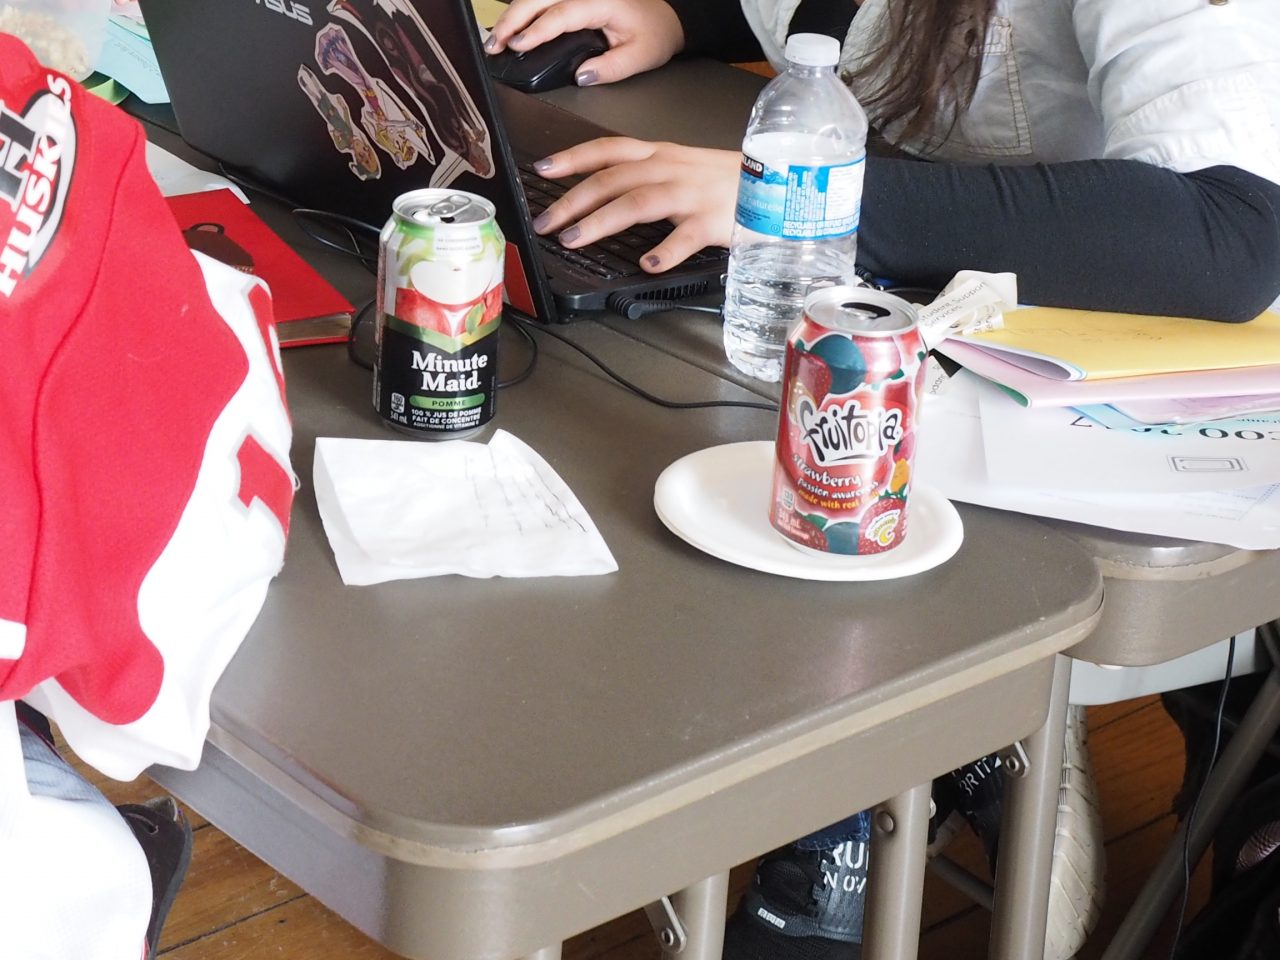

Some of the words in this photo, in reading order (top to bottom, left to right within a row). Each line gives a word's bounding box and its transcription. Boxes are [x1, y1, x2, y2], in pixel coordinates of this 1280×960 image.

[411, 350, 488, 373] Minute
[421, 371, 479, 392] Maid
[431, 399, 466, 408] POMME
[411, 408, 423, 417] 100
[448, 410, 458, 418] DE
[412, 415, 428, 424] FAIT
[792, 453, 862, 487] strawberry
[820, 499, 841, 509] with
[842, 499, 860, 509] real
[823, 841, 869, 871] RU
